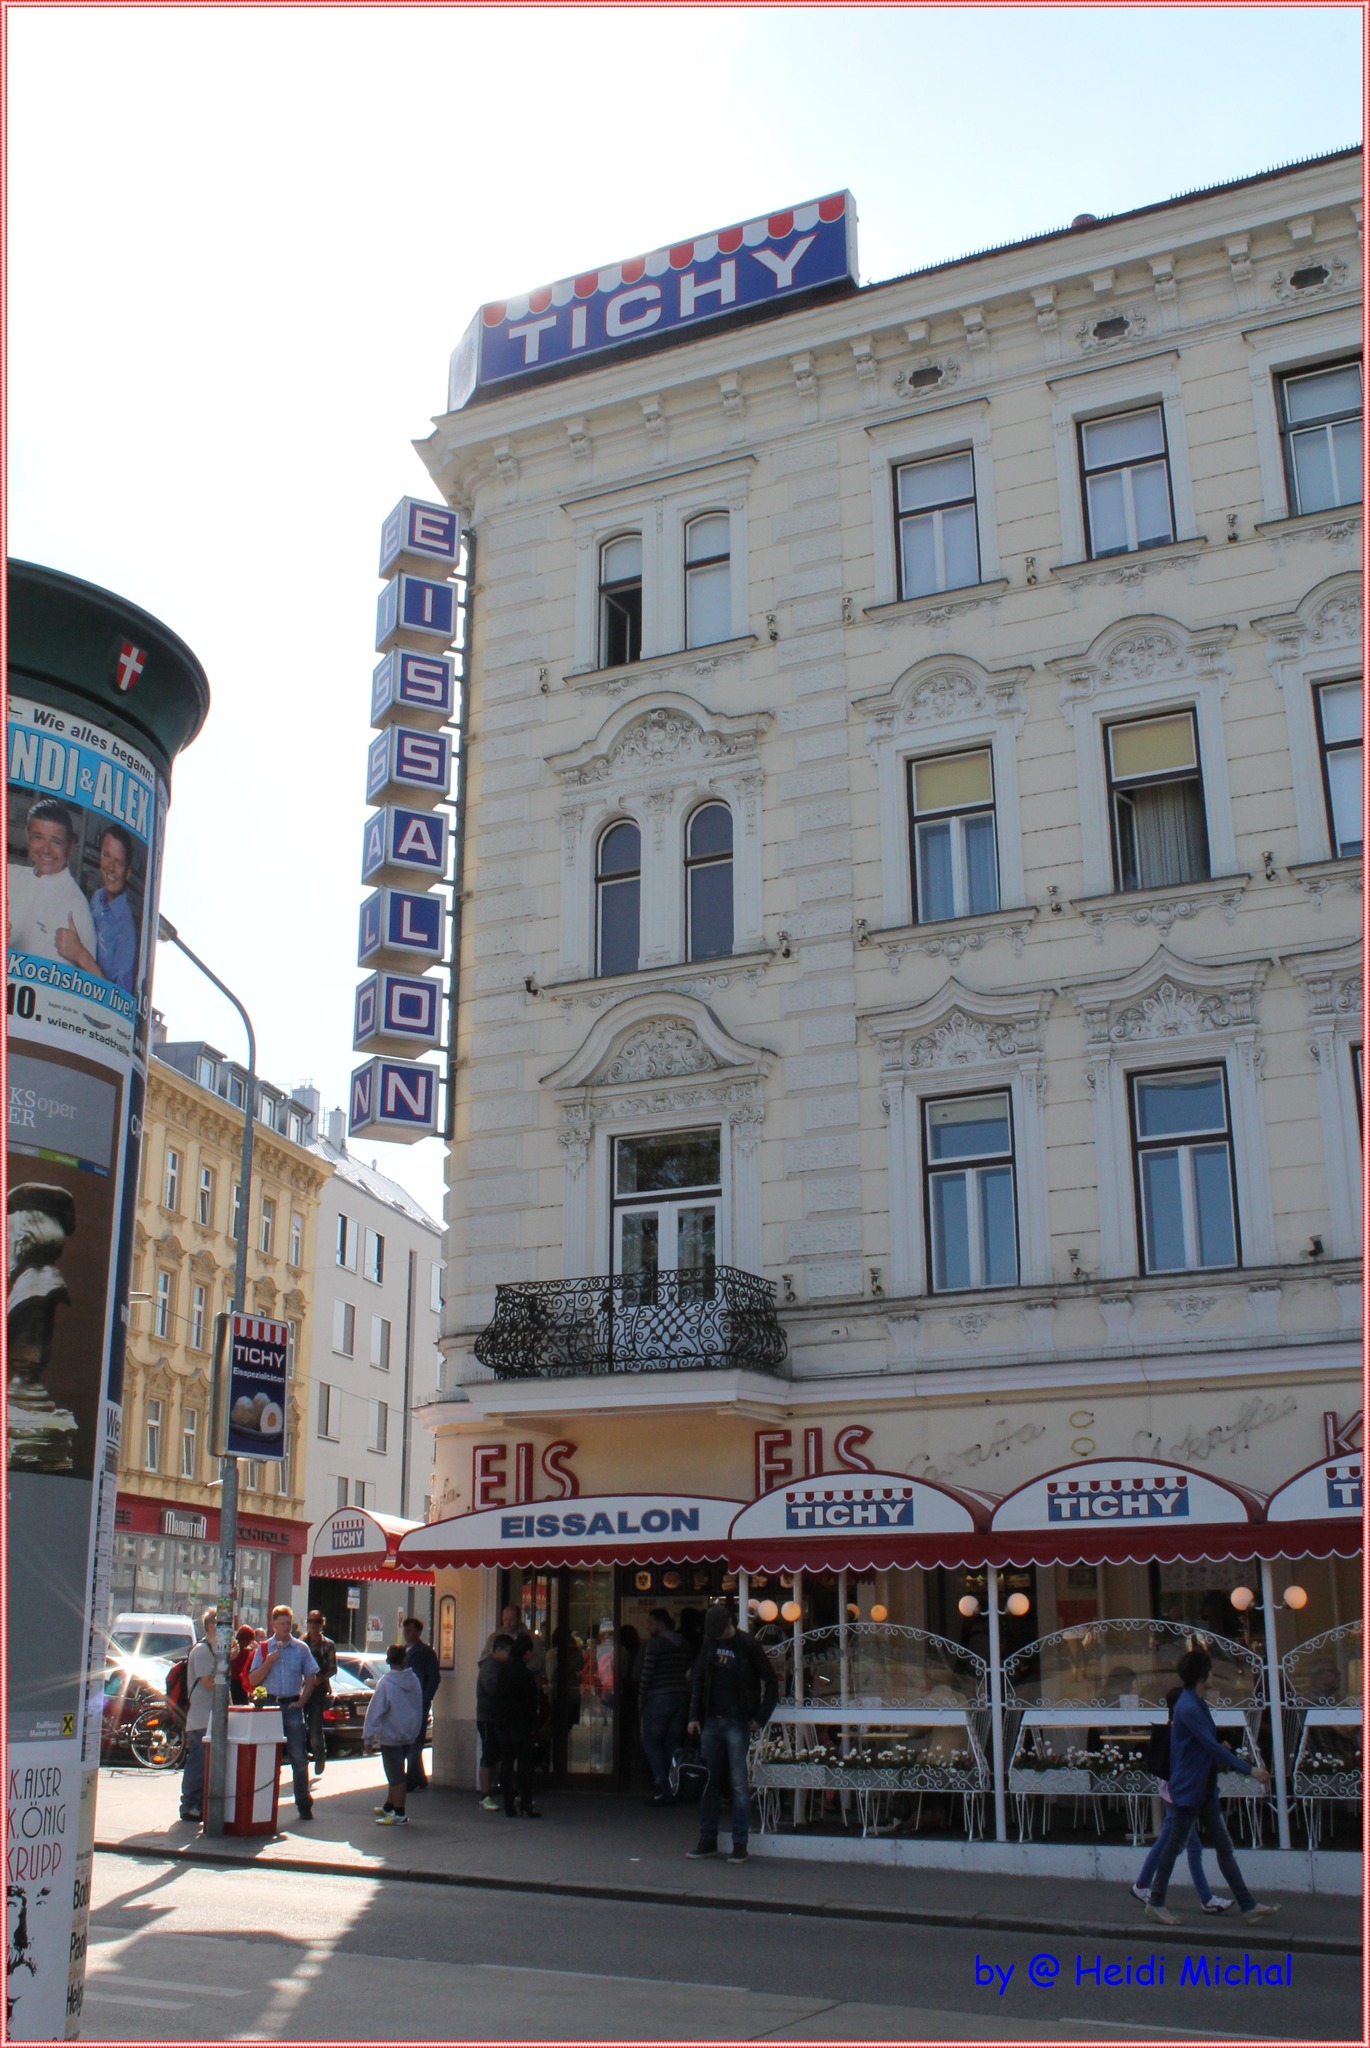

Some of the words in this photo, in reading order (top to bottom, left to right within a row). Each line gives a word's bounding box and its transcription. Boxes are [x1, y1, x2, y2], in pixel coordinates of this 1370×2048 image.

[508, 233, 818, 365] TICHY
[33, 707, 65, 732] Wie
[70, 724, 108, 750] alles
[112, 741, 153, 784] begann:
[8, 953, 106, 1003] Kochshow
[109, 987, 135, 1018] live!
[48, 1016, 87, 1035] wiener
[89, 1030, 130, 1057] stadthalle
[234, 1344, 285, 1369] TICHY
[232, 1366, 285, 1383] Eisspezialitäten
[472, 1440, 579, 1511] EIS
[755, 1424, 876, 1499] EIS
[791, 1503, 906, 1526] TICHY
[1053, 1492, 1180, 1518] TICHY
[165, 1510, 207, 1539] MANHATTAN
[501, 1507, 699, 1539] EISSALON
[334, 1530, 365, 1550] TICHY
